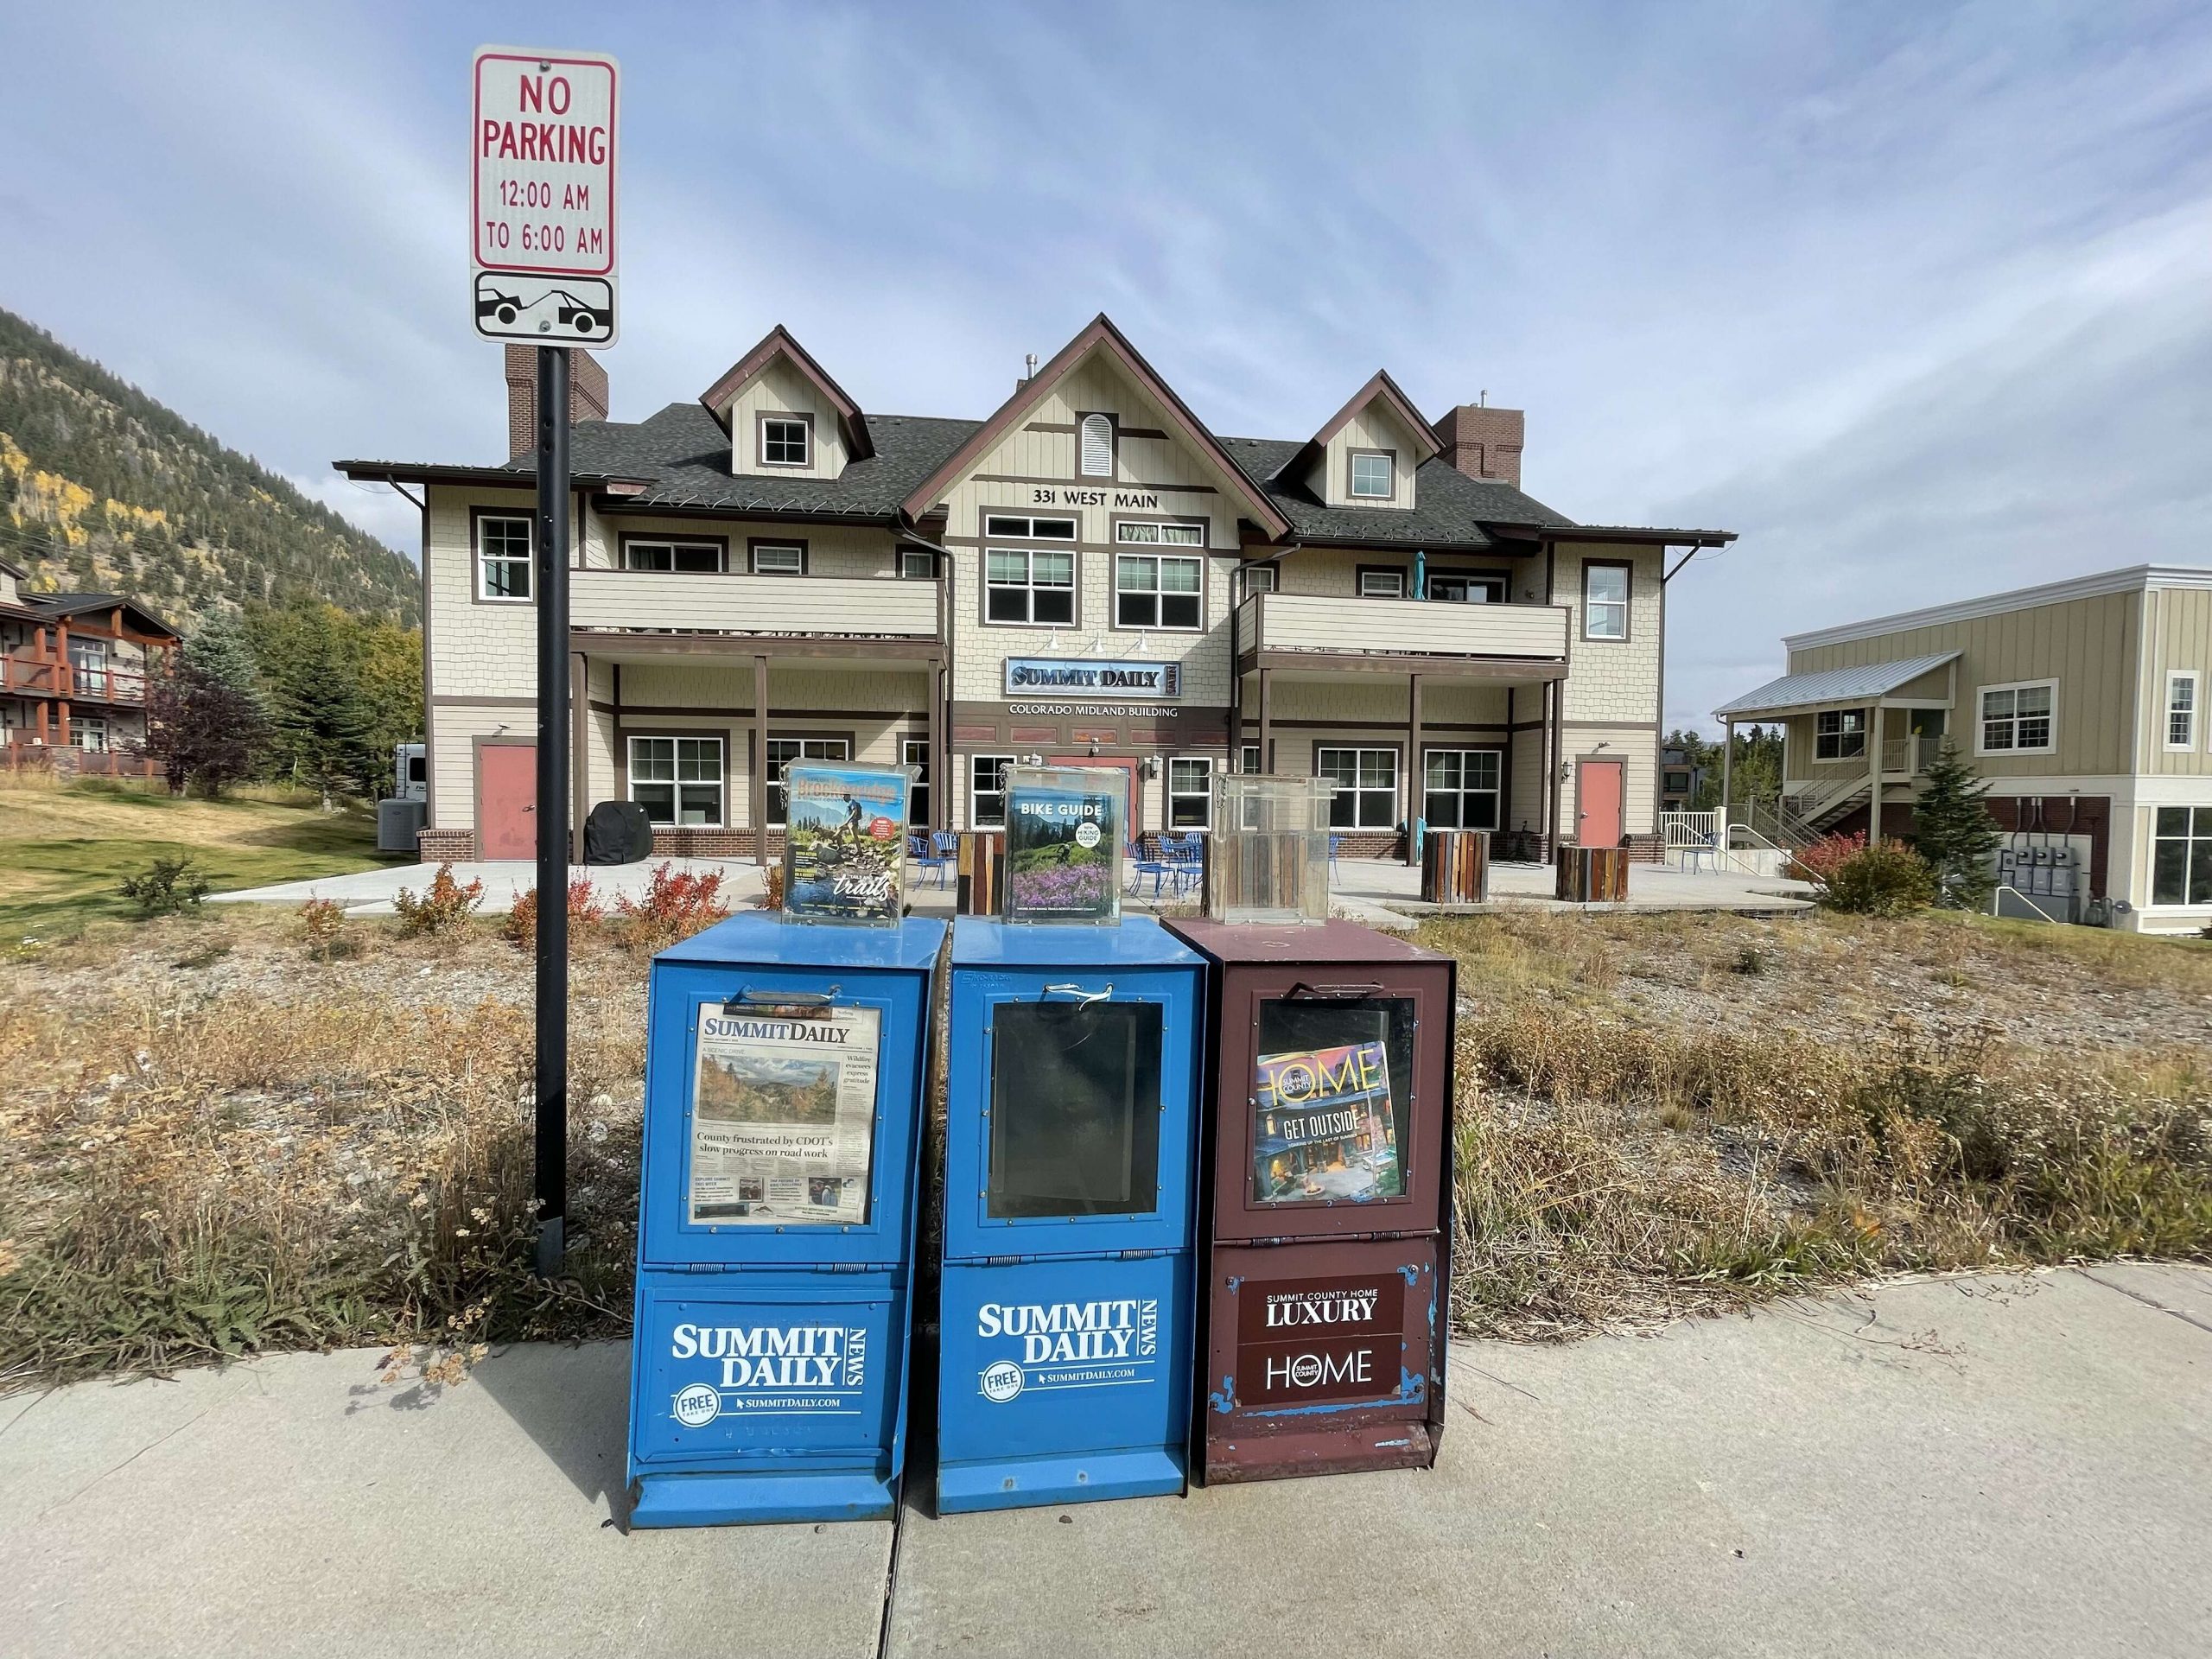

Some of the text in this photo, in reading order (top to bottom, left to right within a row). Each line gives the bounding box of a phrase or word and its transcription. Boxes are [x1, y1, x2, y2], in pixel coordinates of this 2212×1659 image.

[519, 74, 571, 115] NO
[483, 119, 606, 165] PARKING
[499, 180, 589, 212] 12:00 AM
[486, 221, 602, 254] TO 6:00 AM
[1033, 489, 1158, 508] 331 WEST MAIN
[1012, 666, 1159, 688] SUMMIT DAILY
[1009, 704, 1178, 718] COLORADO MIDLAND BUILDING
[1020, 803, 1103, 817] BIKE GUIDE
[833, 870, 890, 901] trails
[1282, 1075, 1309, 1085] SUMMIT
[1282, 1081, 1312, 1094] COUNTY
[1283, 1109, 1360, 1140] GET OUTSIDE
[697, 1131, 833, 1147] County frustrated by CDOT's
[699, 1144, 719, 1153] slow
[722, 1147, 764, 1156] progress
[779, 1147, 802, 1157] road
[803, 1149, 828, 1158] work
[1267, 1288, 1378, 1303] SUMMIT COUNTY HOME
[978, 1300, 1137, 1338] SUMMIT
[1266, 1298, 1378, 1327] LUXURY
[1140, 1298, 1158, 1356] NEWS
[671, 1323, 844, 1358] SUMMIT
[1023, 1328, 1136, 1364] DAILY
[847, 1328, 866, 1386] NEWS
[720, 1357, 842, 1388] DAILY
[987, 1369, 1018, 1389] FREE
[1046, 1369, 1135, 1383] SUMMITDAILY.COM
[1266, 1350, 1373, 1390] HOME
[680, 1393, 714, 1413] FREE
[682, 1409, 700, 1418] TAKE
[746, 1397, 841, 1408] SUMMITDAILY.COM
